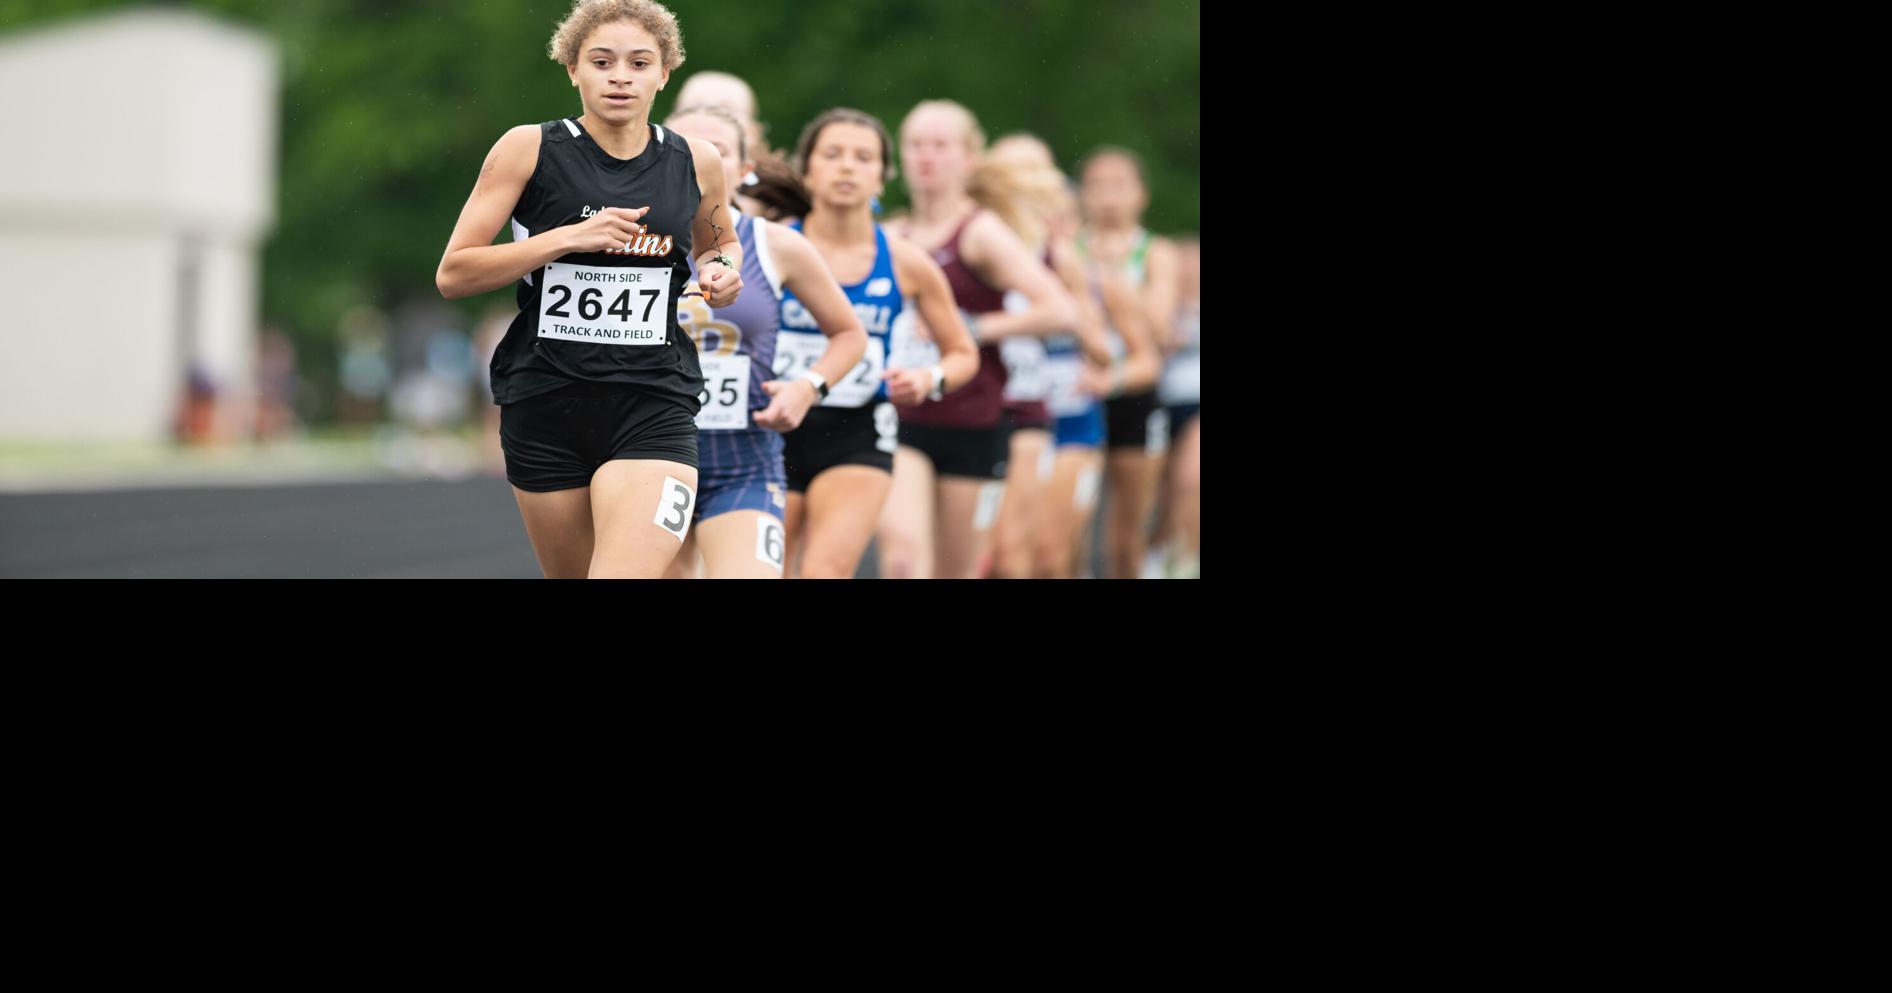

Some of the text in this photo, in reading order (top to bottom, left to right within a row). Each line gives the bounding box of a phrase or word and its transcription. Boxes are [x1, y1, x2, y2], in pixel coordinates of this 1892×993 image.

[574, 271, 643, 283] NORTH SIDE
[545, 284, 661, 323] 2647
[553, 324, 653, 340] TRACK AND FIELD
[697, 378, 738, 407] 55
[662, 484, 691, 533] 3
[765, 524, 785, 564] 6
